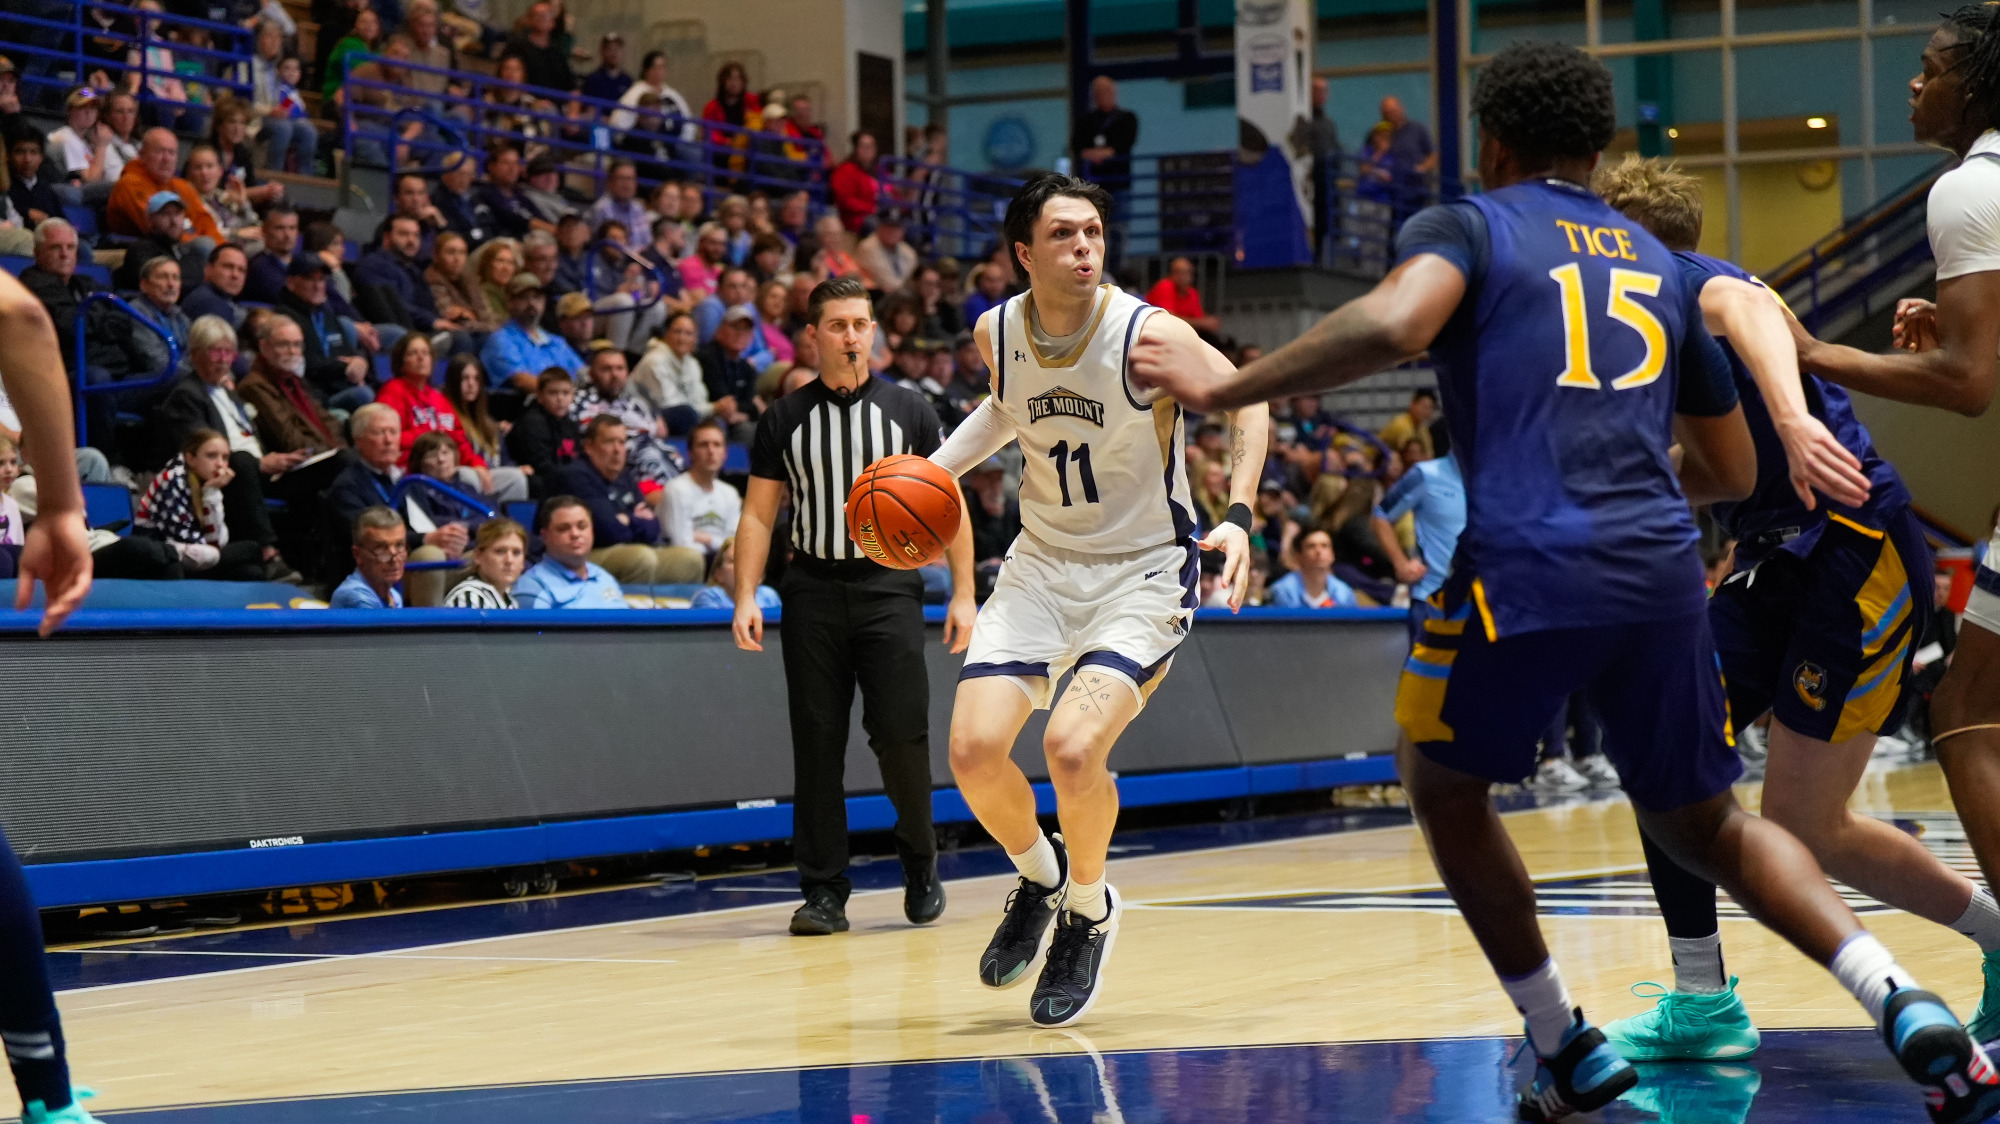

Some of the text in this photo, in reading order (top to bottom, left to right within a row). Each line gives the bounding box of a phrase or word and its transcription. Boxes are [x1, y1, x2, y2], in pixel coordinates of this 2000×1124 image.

[1555, 219, 1638, 262] TICE
[1549, 262, 1667, 391] 15
[1028, 397, 1103, 425] THE MOUNT
[1048, 440, 1099, 507] 11
[1099, 693, 1111, 701] KT
[249, 836, 305, 849] DAKTRONICS
